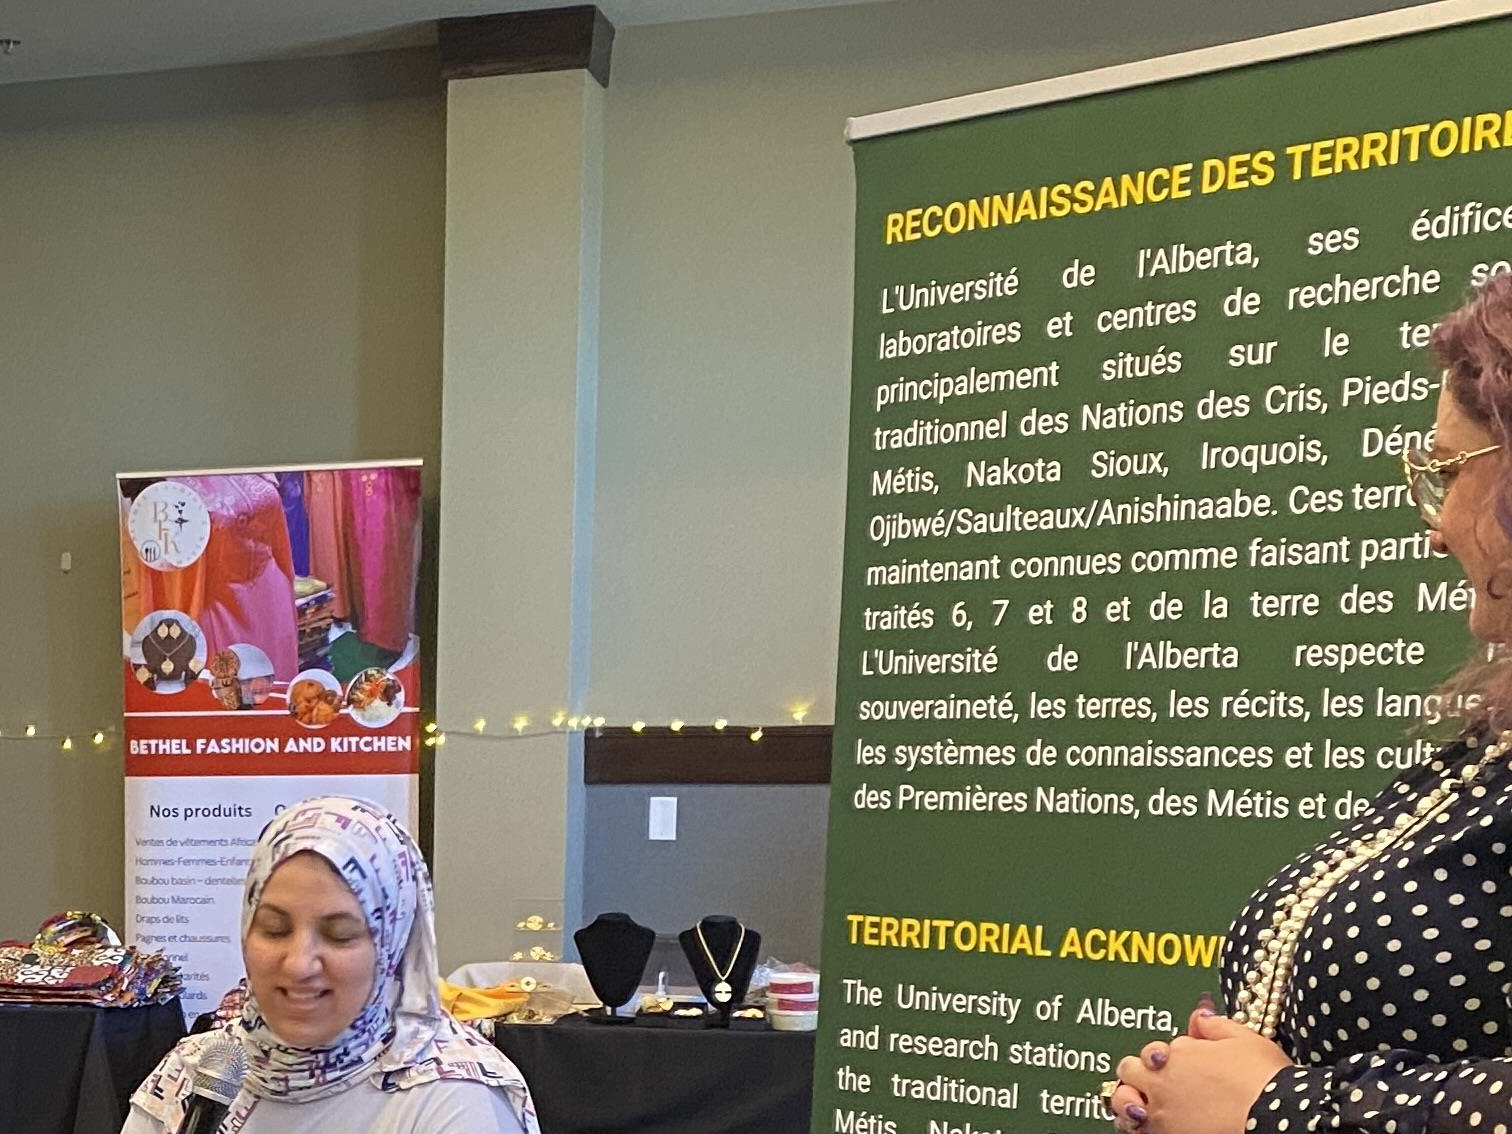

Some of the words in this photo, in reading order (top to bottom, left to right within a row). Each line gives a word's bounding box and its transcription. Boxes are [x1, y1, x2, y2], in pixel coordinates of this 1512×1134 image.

[885, 162, 1194, 245] RECONNAISSANCE
[1201, 150, 1276, 194] DES
[881, 266, 1019, 314] L'Université
[1062, 258, 1096, 289] de
[1138, 240, 1260, 279] l'Alberta,
[1307, 226, 1360, 256] ses
[879, 320, 1022, 360] laboratoires
[1046, 311, 1074, 339] et
[1096, 299, 1197, 333] centres
[1223, 286, 1261, 317] de
[1288, 264, 1441, 311] recherche
[876, 361, 1060, 413] principalement
[1101, 345, 1182, 381] situés
[1228, 341, 1278, 367] sur
[1324, 326, 1350, 358] le
[1399, 321, 1443, 349] te
[873, 410, 1008, 451] traditionnel
[1019, 407, 1069, 437] des
[1081, 399, 1184, 431] Nations
[1196, 389, 1251, 420] des
[1265, 382, 1328, 415] Cris,
[1342, 369, 1449, 408] Pieds-
[872, 466, 939, 497] Métis,
[966, 457, 1061, 488] Nakota
[1090, 449, 1169, 479] Sioux,
[1201, 434, 1328, 474] Iroquois,
[869, 490, 1278, 547] Ojibwé/Saulteaux/Anishinaabe.
[1288, 485, 1344, 515] Ces
[866, 554, 1001, 586] maintenant
[1010, 552, 1122, 579] connues
[1130, 546, 1238, 573] comme
[1248, 536, 1351, 567] faisant
[863, 601, 935, 631] traités
[951, 600, 973, 631] 6,
[992, 599, 1010, 626] 7
[1028, 599, 1054, 625] et
[1071, 596, 1088, 624] 8
[1105, 596, 1132, 623] et
[1149, 591, 1183, 621] de
[1203, 589, 1228, 619] la
[1249, 591, 1320, 618] terre
[1340, 583, 1394, 615] des
[861, 645, 998, 676] L'Université
[1046, 643, 1079, 672] de
[1125, 640, 1239, 670] l'Alberta
[1295, 637, 1425, 674] respecte
[859, 691, 1019, 724] souveraineté,
[1030, 691, 1066, 719] les
[1075, 693, 1158, 723] terres,
[1169, 689, 1210, 719] les
[1221, 688, 1311, 723] récits,
[1322, 687, 1364, 718] les
[129, 737, 191, 755] BETHEL
[196, 737, 279, 754] FASHION
[284, 737, 324, 754] AND
[330, 735, 411, 752] KITCHEN
[856, 738, 887, 765] les
[894, 738, 1016, 772] systèmes
[1025, 738, 1058, 767] de
[1065, 739, 1274, 769] connaissances
[1284, 741, 1314, 769] et
[1324, 738, 1365, 769] les
[1376, 738, 1443, 772] cult
[149, 804, 179, 818] Nos
[183, 803, 253, 821] produits
[853, 782, 892, 810] des
[898, 784, 1028, 813] Premières
[1035, 786, 1140, 820] Nations,
[1148, 786, 1198, 817] des
[1207, 788, 1290, 819] Métis
[1298, 792, 1327, 820] et
[166, 838, 178, 847] de
[136, 876, 169, 886] Boubou
[136, 895, 169, 905] Boubou
[171, 895, 216, 905] Marocain
[136, 913, 161, 925] Draps
[162, 914, 174, 924] de
[136, 933, 167, 945] Pagnes
[168, 934, 178, 943] et
[179, 934, 231, 943] chaussures
[846, 914, 1052, 957] TERRITORIAL
[1059, 927, 1226, 968] ACKNOW
[842, 978, 883, 1007] The
[897, 983, 1022, 1025] University
[1035, 994, 1064, 1022] of
[1076, 997, 1179, 1037] Alberta,
[839, 1024, 880, 1050] and
[889, 1033, 999, 1062] research
[1008, 1041, 1111, 1073] stations
[836, 1065, 871, 1093] the
[890, 1073, 1019, 1109] traditional
